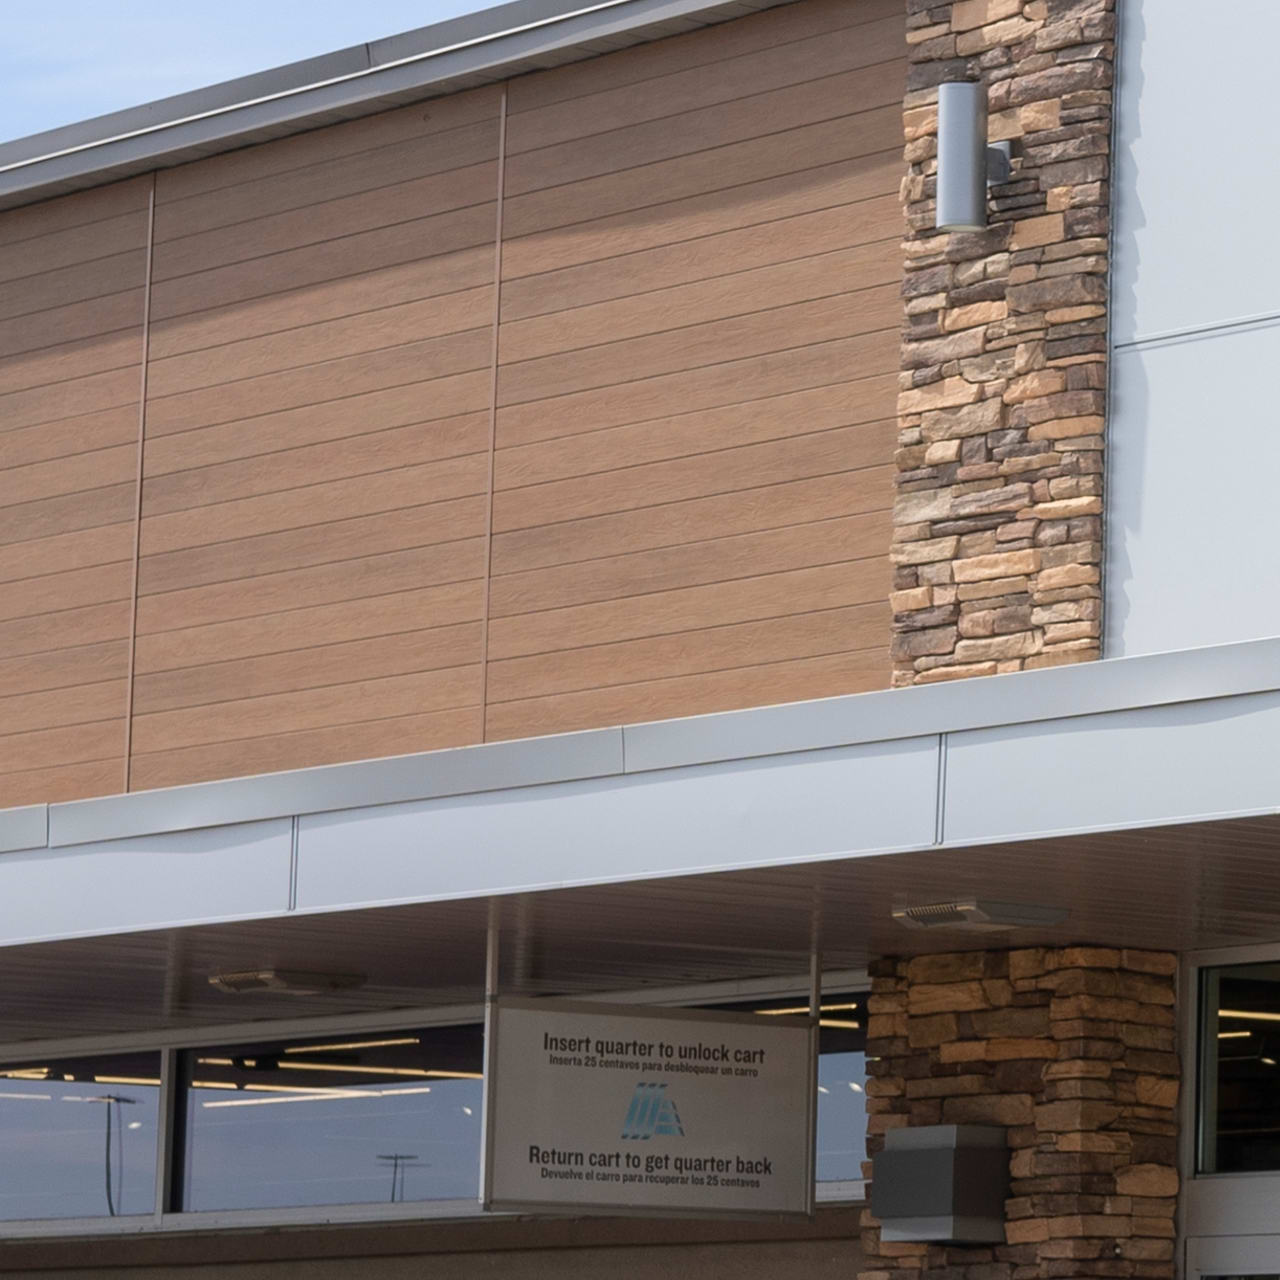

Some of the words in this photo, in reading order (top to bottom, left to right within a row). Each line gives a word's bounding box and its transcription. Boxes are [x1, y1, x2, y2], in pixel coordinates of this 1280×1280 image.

[543, 1031, 592, 1053] Insert
[595, 1039, 654, 1057] quarter
[659, 1042, 674, 1059] to
[679, 1043, 730, 1062] unlock
[734, 1048, 766, 1064] cart
[549, 1054, 582, 1066] Inserta
[584, 1055, 598, 1068] 25
[599, 1058, 640, 1070] centavos
[642, 1061, 663, 1072] para
[664, 1061, 719, 1076] desbloquear
[721, 1067, 733, 1076] un
[734, 1067, 759, 1078] carro
[528, 1145, 584, 1167] Return
[588, 1152, 621, 1168] cart
[625, 1152, 641, 1168] to
[645, 1154, 670, 1173] get
[674, 1156, 732, 1174] quarter
[736, 1155, 773, 1175] back
[541, 1167, 584, 1180] Devuelve
[585, 1170, 594, 1181] el
[596, 1173, 621, 1182] carro
[622, 1173, 643, 1184] para
[645, 1174, 689, 1186] recuperar
[691, 1175, 705, 1186] los
[706, 1175, 719, 1187] 25
[720, 1177, 761, 1189] centavos
